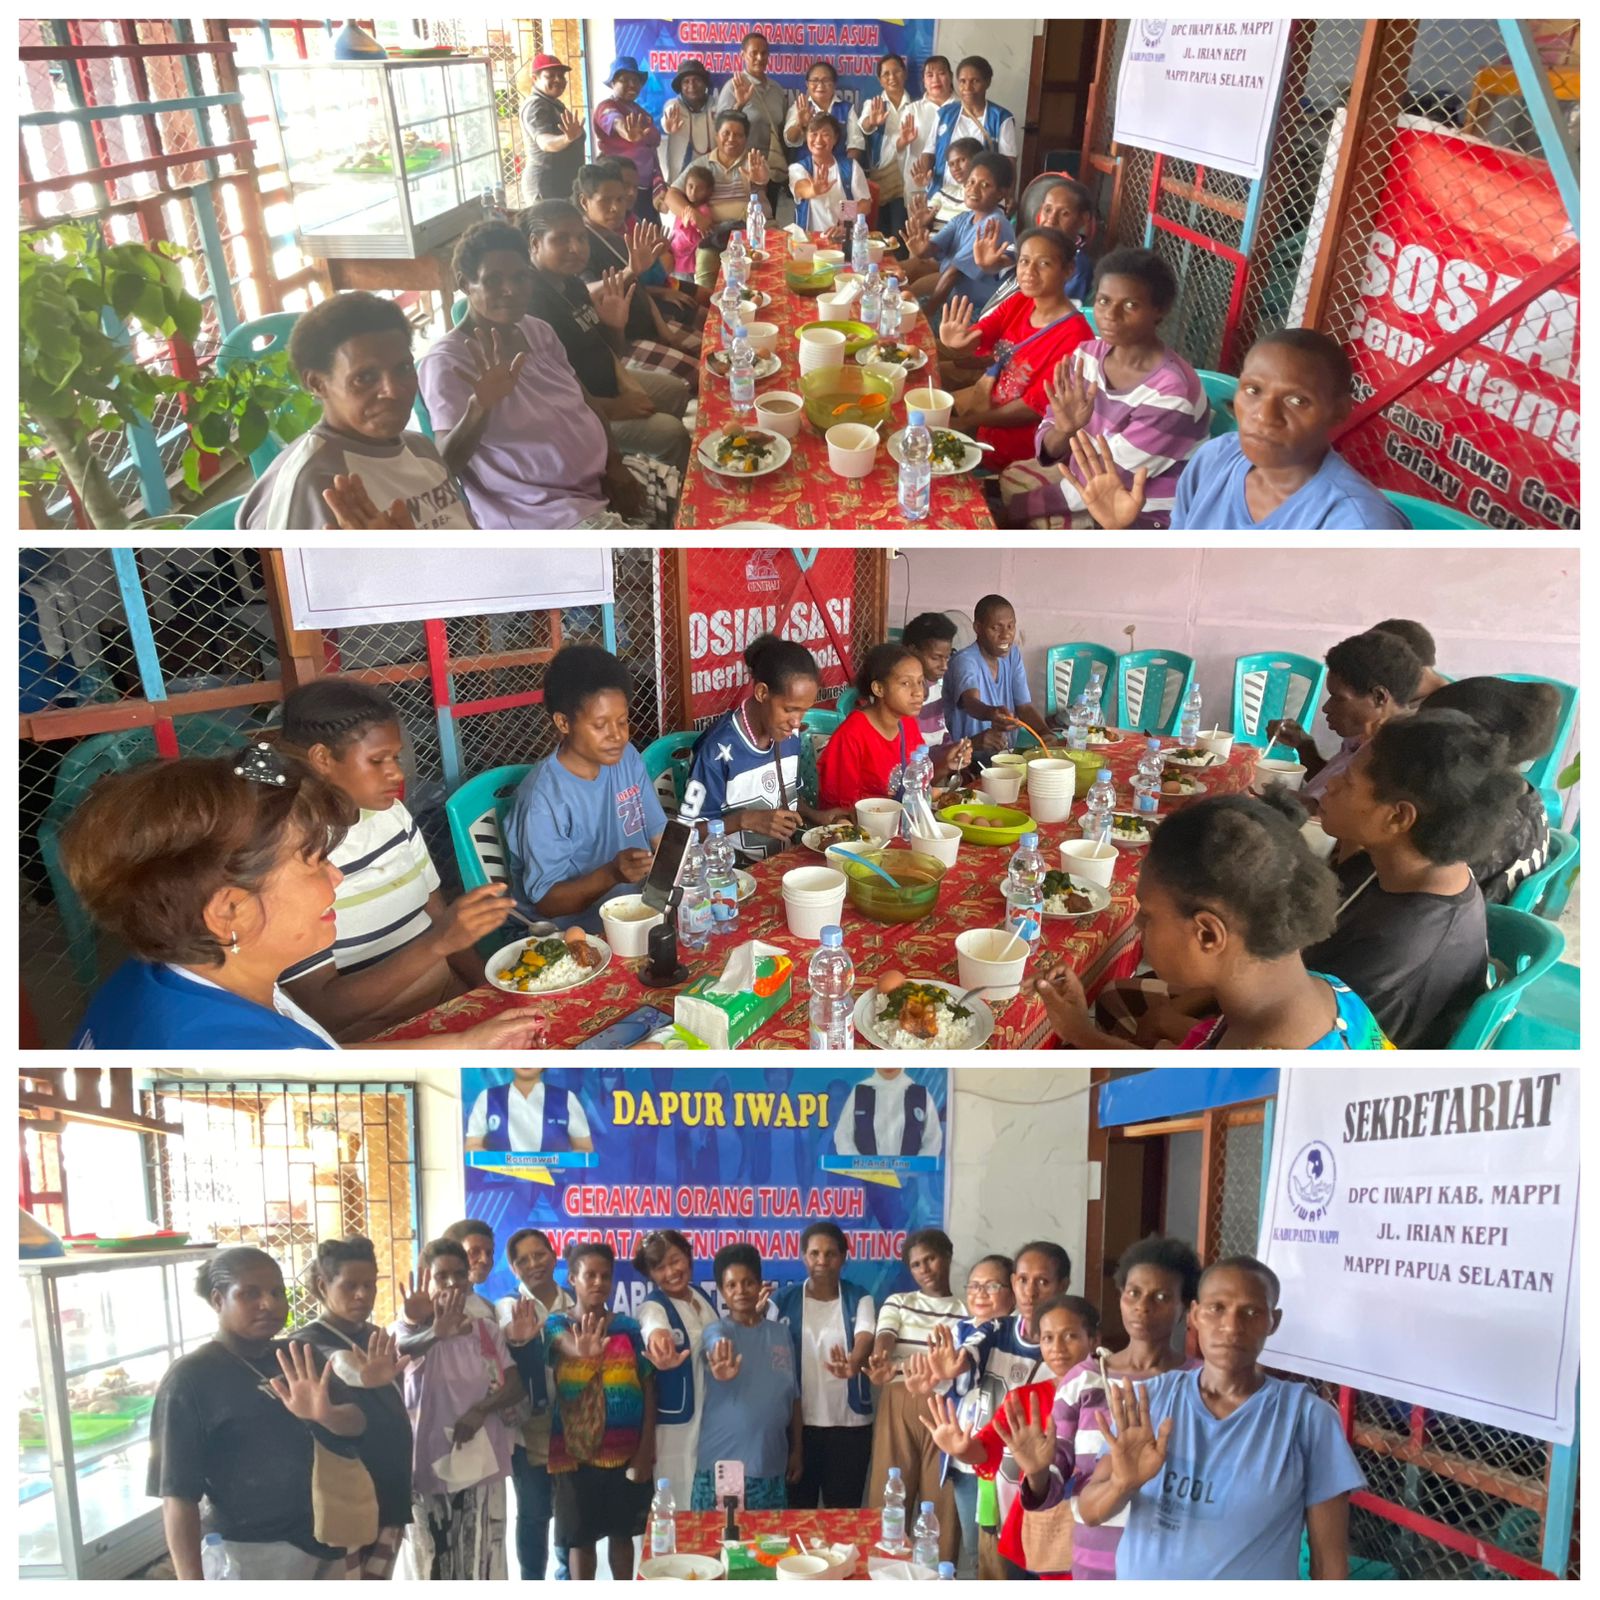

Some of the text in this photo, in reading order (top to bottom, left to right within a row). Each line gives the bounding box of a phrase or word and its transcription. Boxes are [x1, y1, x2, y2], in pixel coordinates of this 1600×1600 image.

[679, 21, 750, 43] GERAKAN
[807, 24, 837, 46] TUA
[839, 25, 879, 47] ASUH
[1171, 21, 1273, 36] DPC IWAPI KAB. MAPPI
[1182, 47, 1246, 62] JL. IRIAN KEPI
[1166, 69, 1264, 89] MAPPI PAPUA SELATAN
[680, 779, 707, 818] 9
[612, 1090, 830, 1129] DAPUR IWAPI
[1342, 1072, 1562, 1145] SEKRETARIAT
[564, 1185, 865, 1219] GERAKAN ORANG TUA ASUH
[1347, 1183, 1561, 1206] DPC IWAPI KAB. MAPPI
[1292, 1203, 1328, 1223] IWAPI
[1272, 1227, 1340, 1245] KABUPATEN MAPPI
[1376, 1222, 1509, 1248] JL. IRIAN KEPI
[1343, 1254, 1555, 1294] MAPPI PAPUA SELATAN
[1163, 1470, 1215, 1505] COOL
